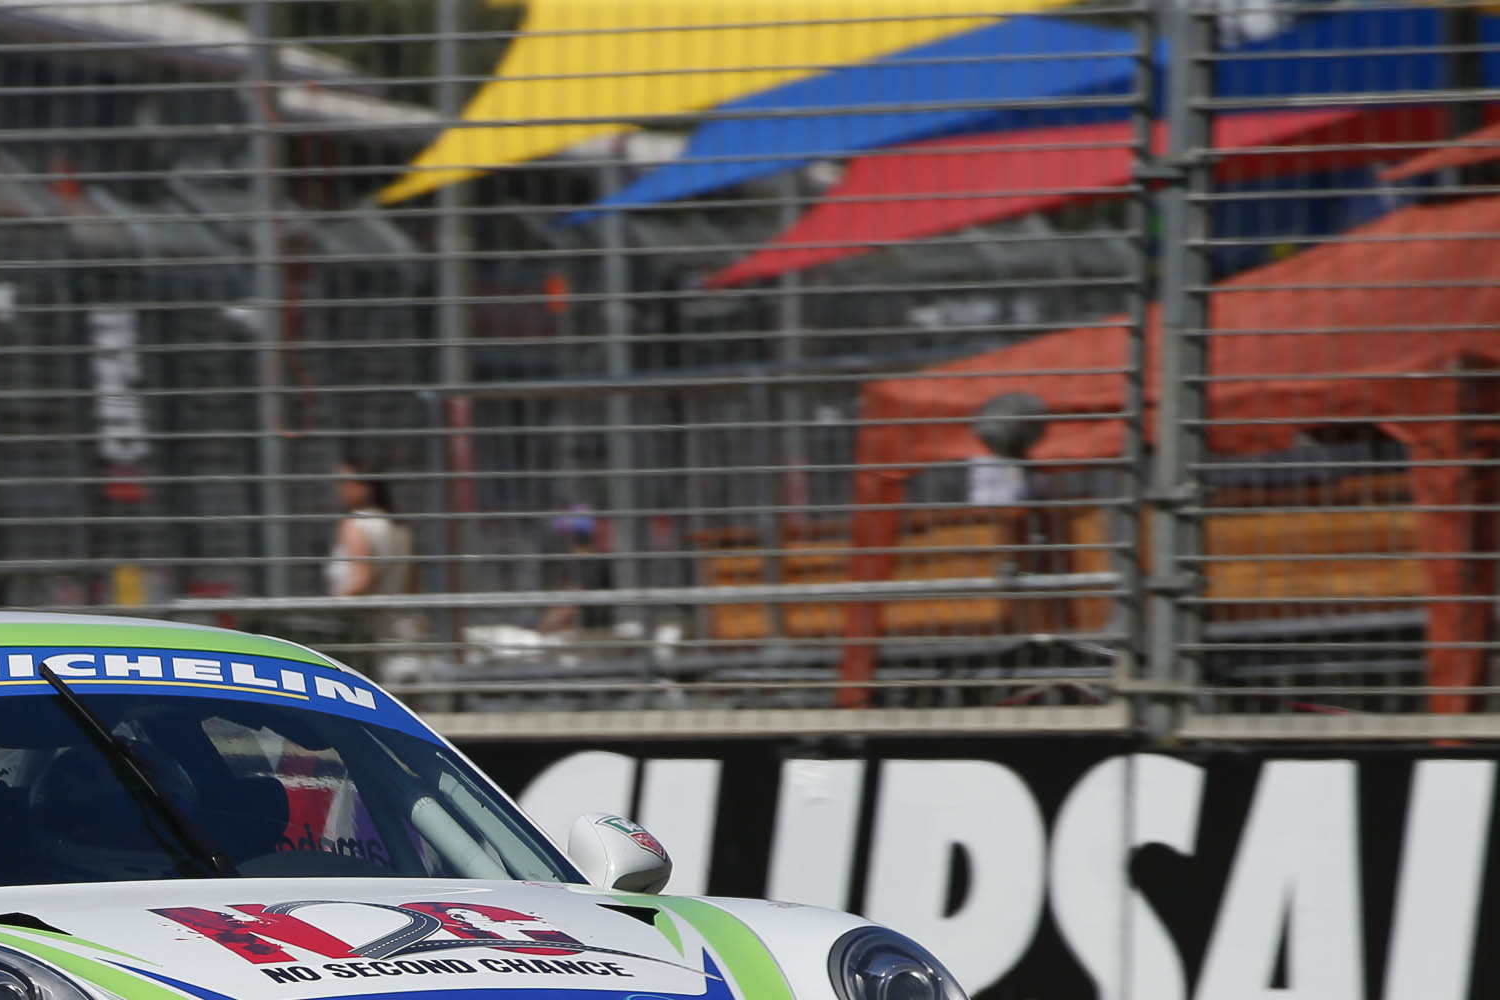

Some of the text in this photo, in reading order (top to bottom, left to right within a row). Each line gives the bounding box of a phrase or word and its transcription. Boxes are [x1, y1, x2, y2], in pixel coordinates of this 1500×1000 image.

[261, 957, 635, 984] NO SECOND CHANCE
